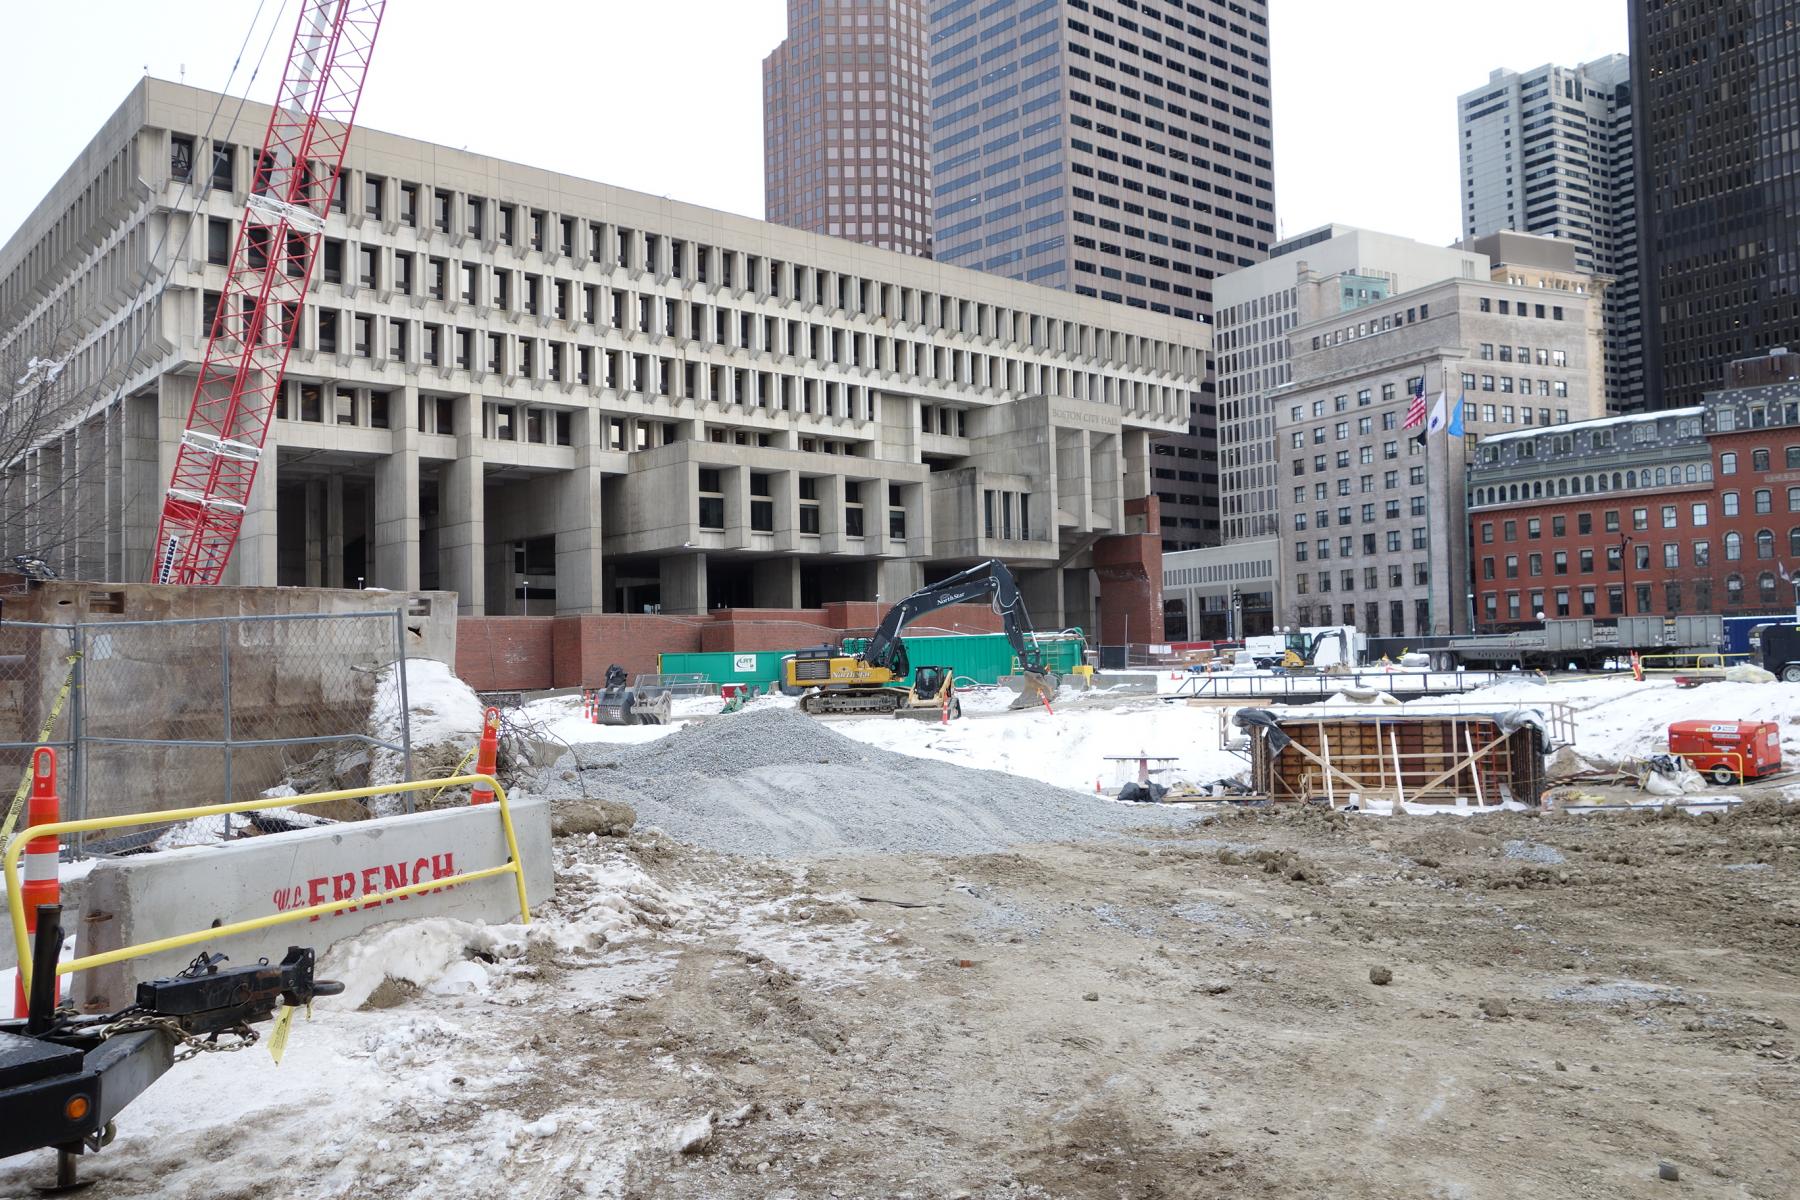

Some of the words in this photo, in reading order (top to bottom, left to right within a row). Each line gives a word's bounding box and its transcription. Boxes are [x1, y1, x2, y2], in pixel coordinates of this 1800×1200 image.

[1052, 409, 1081, 421] BOSTON
[1083, 413, 1099, 424] CITY
[1101, 415, 1119, 426] HALL
[307, 852, 453, 922] FRENCH
